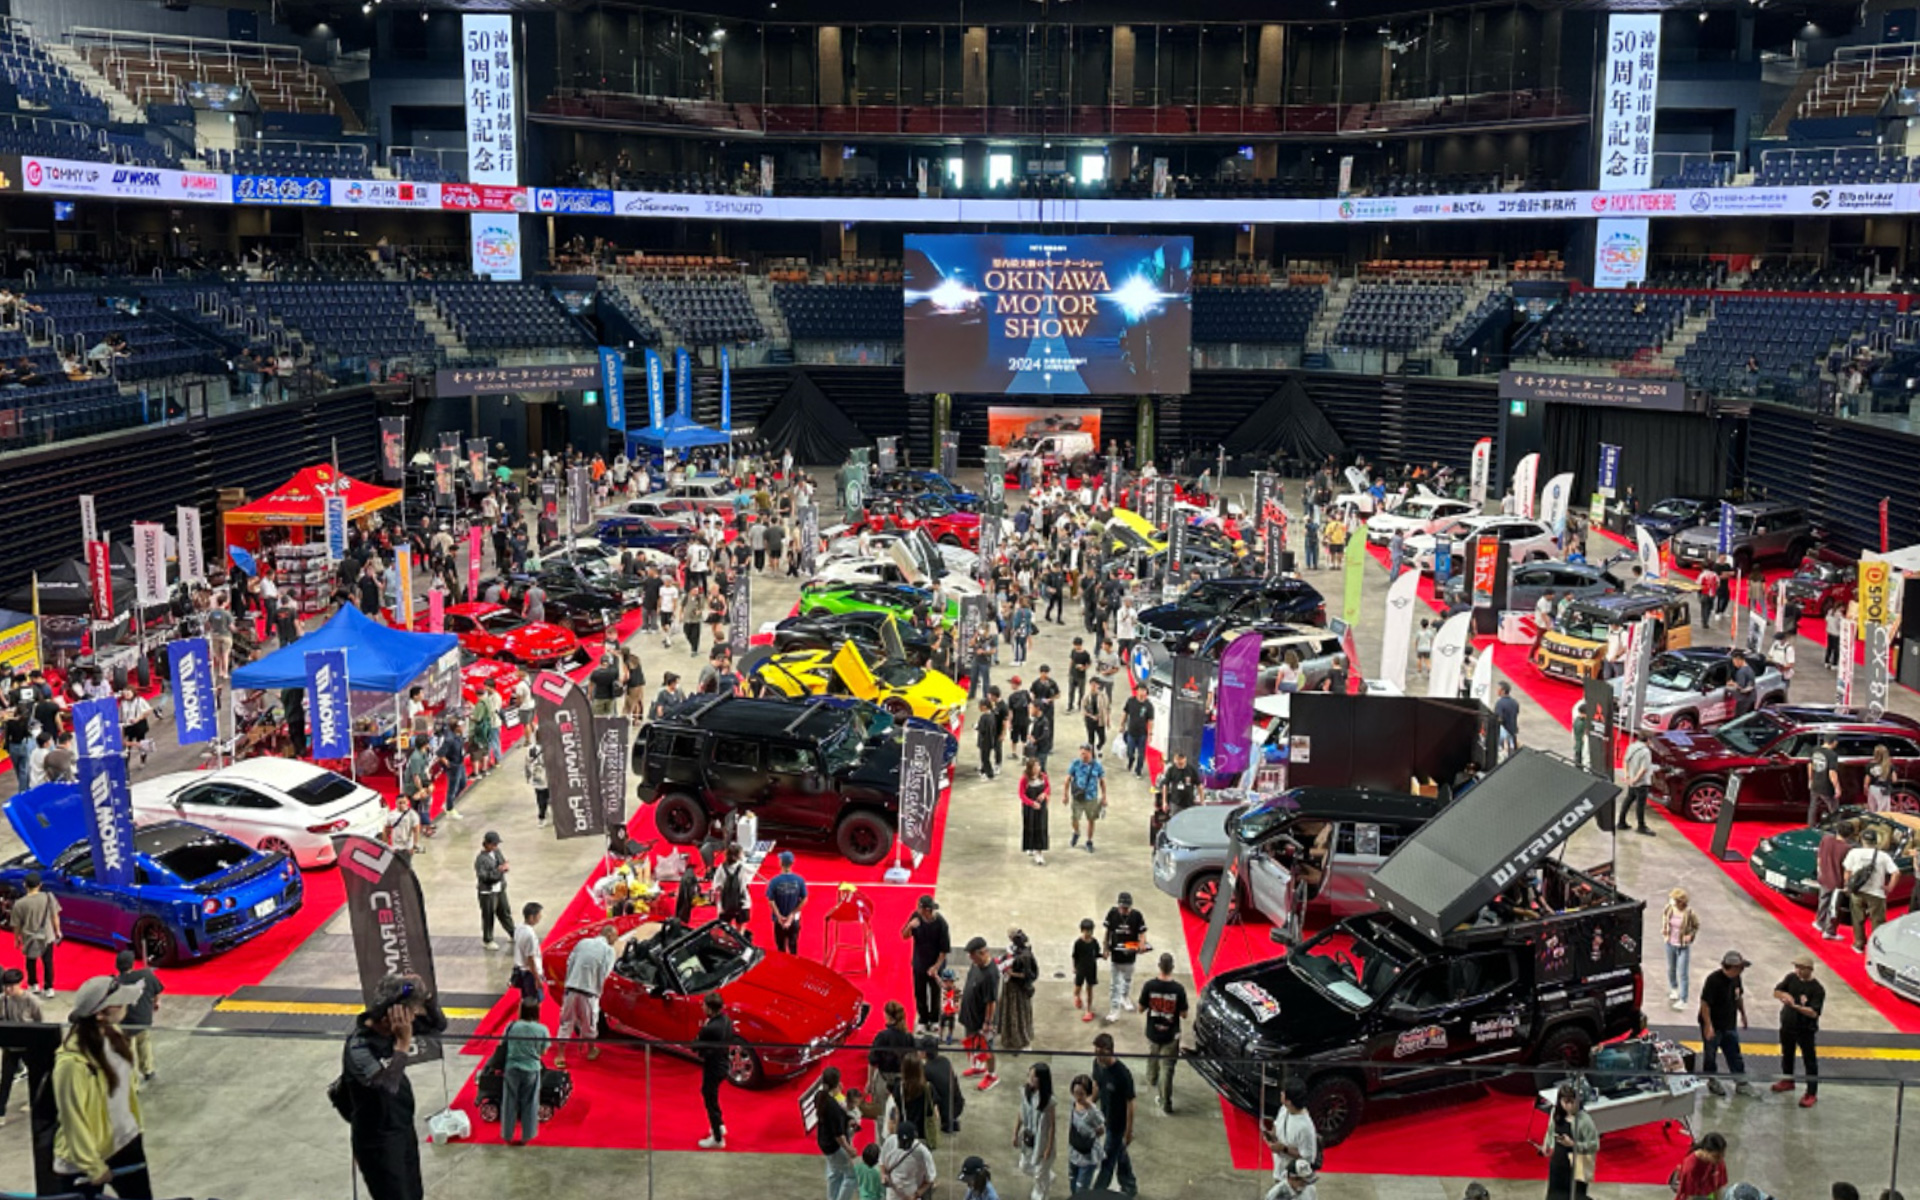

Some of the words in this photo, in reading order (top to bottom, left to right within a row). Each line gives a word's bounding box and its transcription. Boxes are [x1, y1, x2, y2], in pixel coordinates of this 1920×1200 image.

[467, 31, 496, 172] 50周年記念
[1606, 30, 1637, 177] 50周年記念
[129, 171, 161, 186] WORK
[984, 270, 1111, 292] OKINAWA
[995, 294, 1099, 316] MOTOR
[1004, 318, 1089, 339] SHOW
[1008, 358, 1042, 372] 2024
[95, 544, 109, 619] POTENZA
[1513, 797, 1594, 864] TRITON
